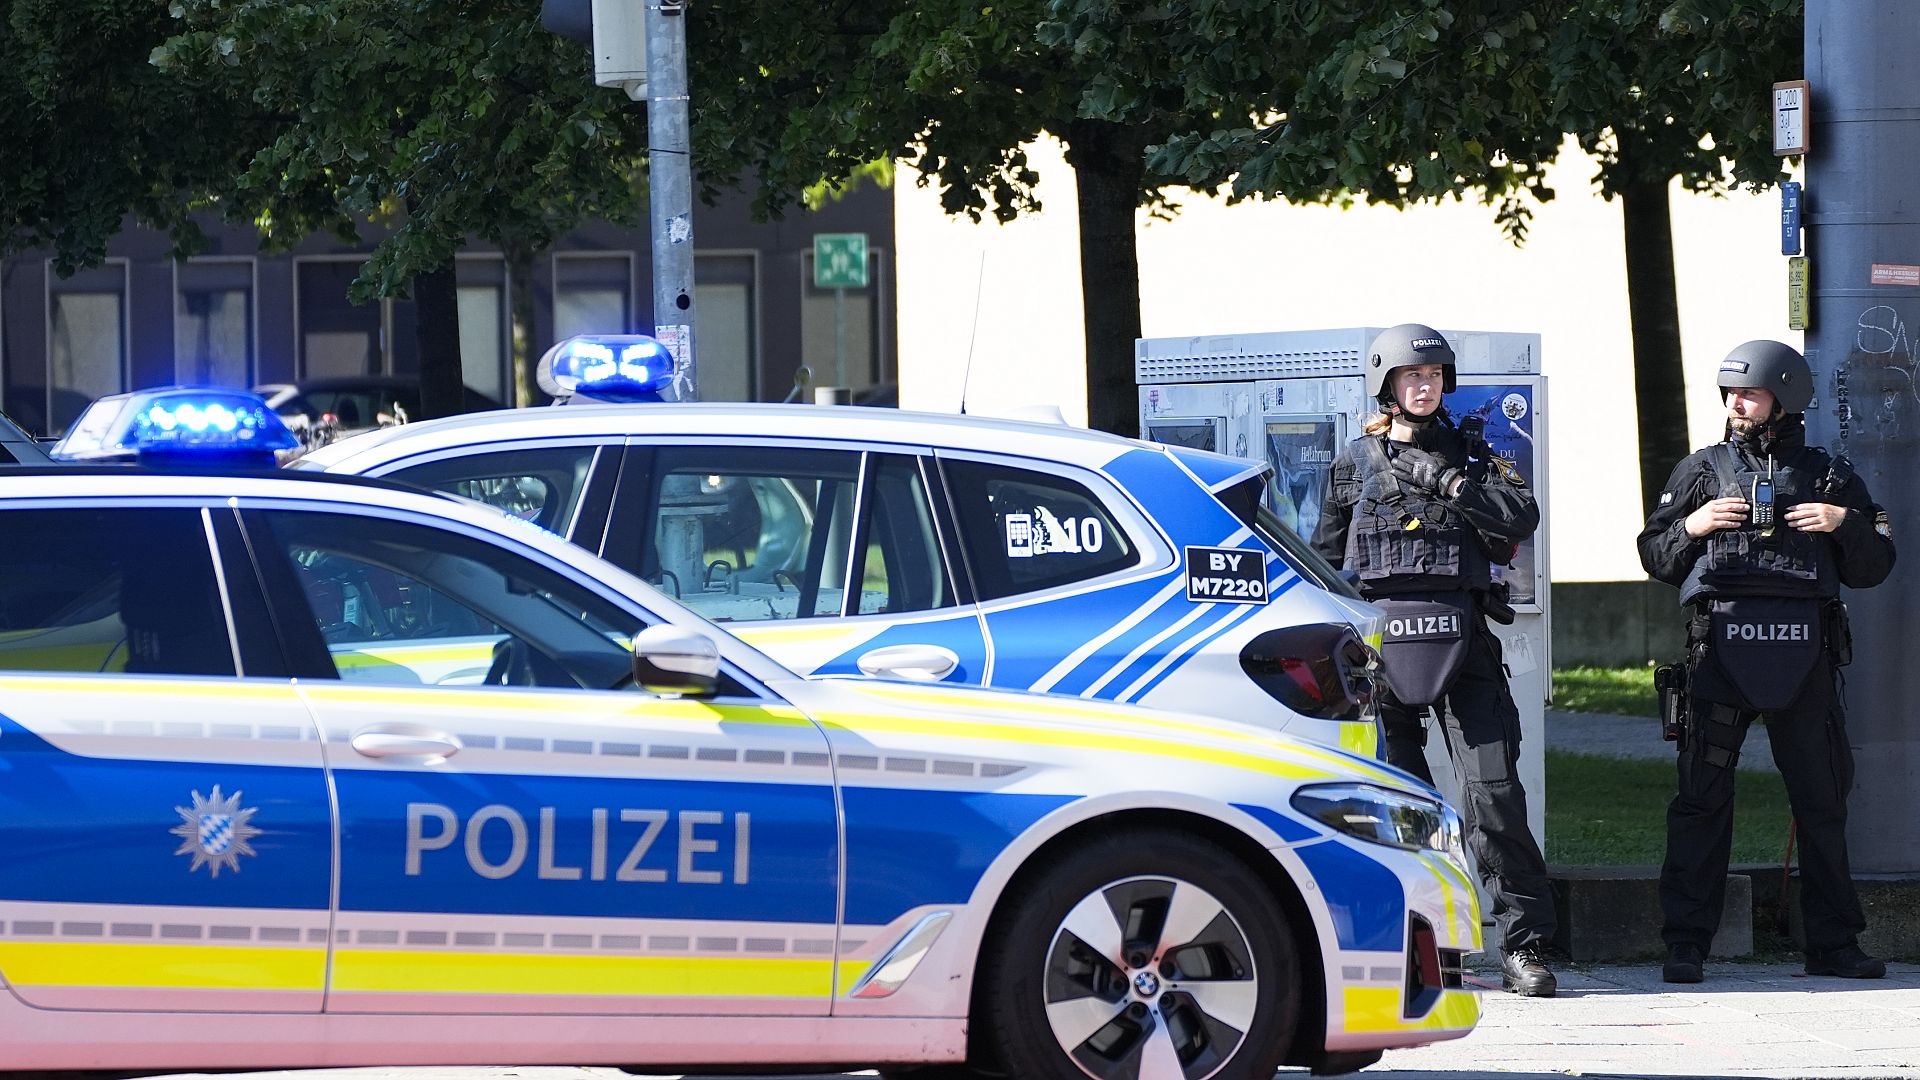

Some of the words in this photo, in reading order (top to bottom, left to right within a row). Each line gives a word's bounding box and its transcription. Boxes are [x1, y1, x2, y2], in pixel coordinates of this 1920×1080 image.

[1413, 339, 1442, 347] POLIZEI
[1048, 517, 1103, 553] 10
[1209, 553, 1243, 572] BY
[1191, 577, 1264, 598] M7220
[1727, 623, 1808, 640] POLIZEI
[405, 802, 750, 884] POLIZEI
